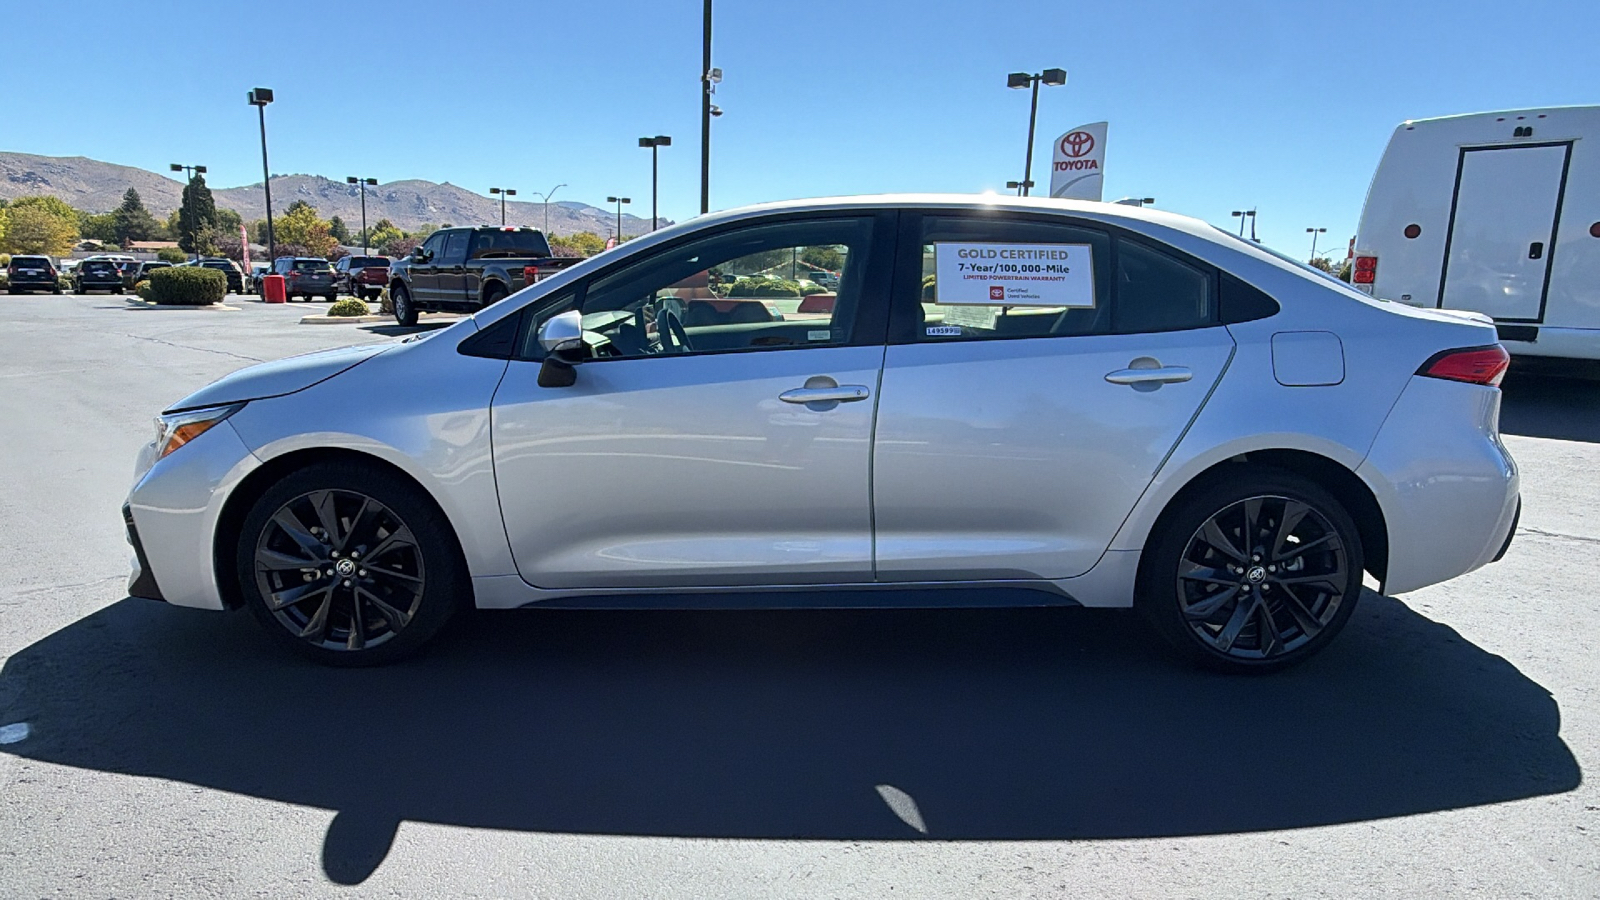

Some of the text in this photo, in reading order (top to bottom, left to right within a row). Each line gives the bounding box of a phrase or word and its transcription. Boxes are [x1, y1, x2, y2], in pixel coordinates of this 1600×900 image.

[1054, 159, 1098, 171] TOYOTA
[958, 248, 1069, 260] GOLD CERTIFIED
[958, 263, 1070, 274] 7-Year/100,000-Mile
